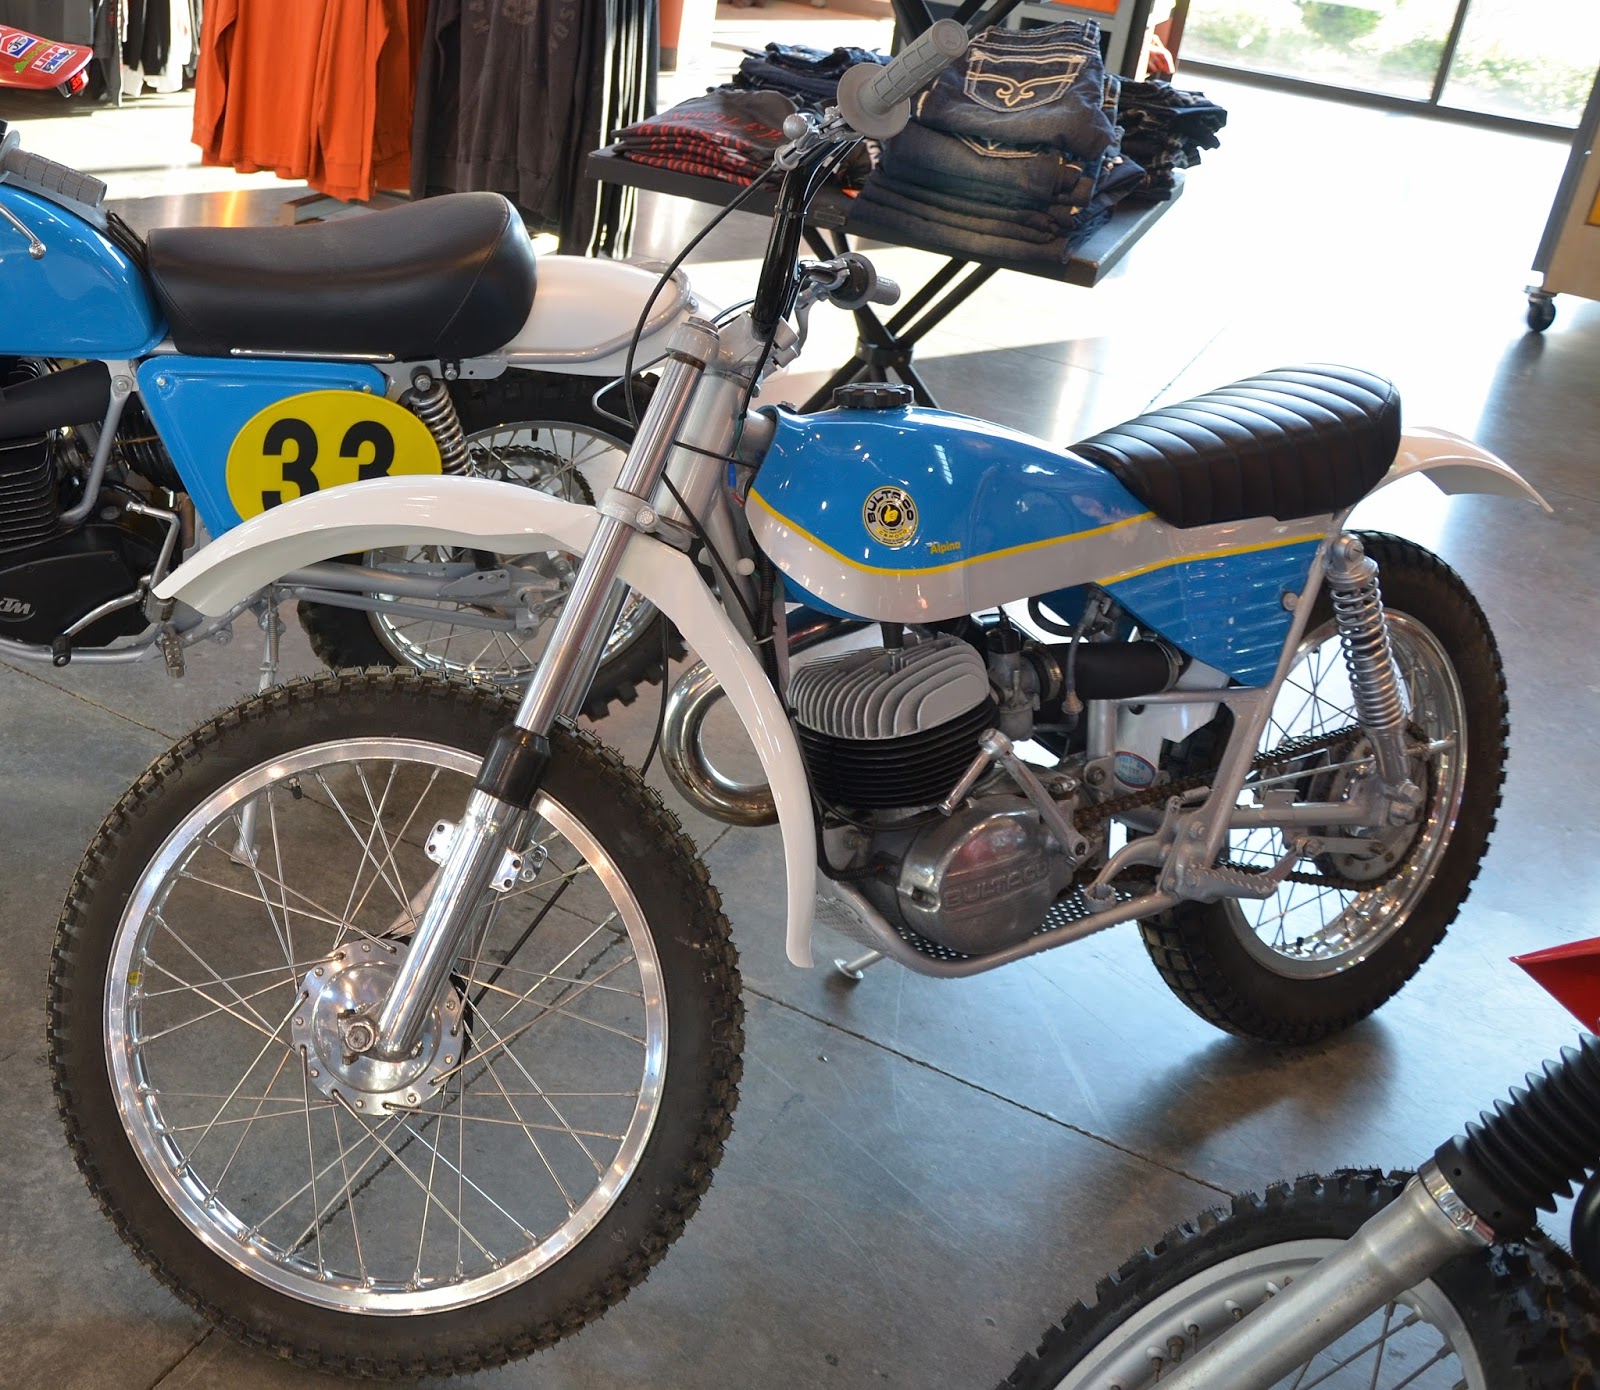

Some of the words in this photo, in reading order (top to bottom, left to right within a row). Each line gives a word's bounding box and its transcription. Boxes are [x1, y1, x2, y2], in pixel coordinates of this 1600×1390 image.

[262, 418, 395, 512] 33
[867, 490, 914, 523] BULTACO
[930, 541, 960, 554] Alpina
